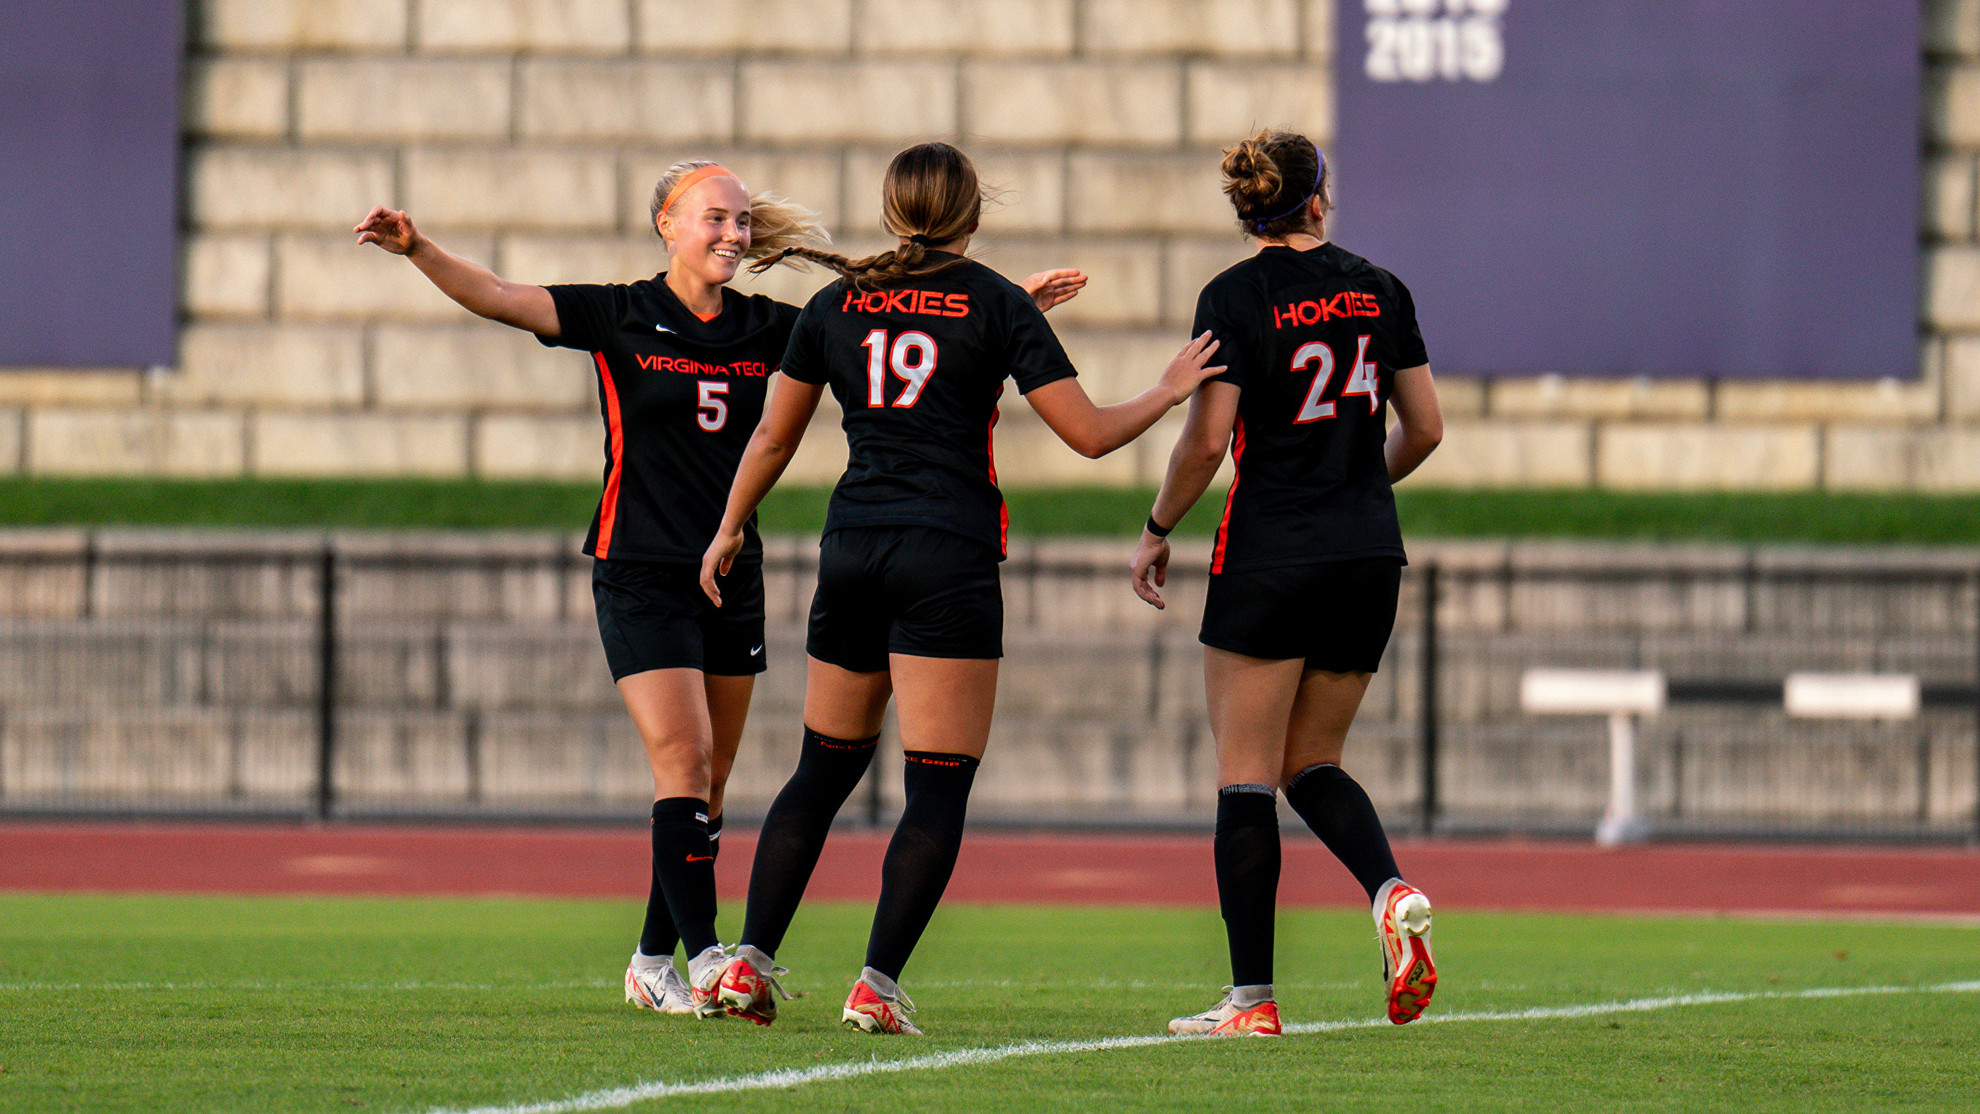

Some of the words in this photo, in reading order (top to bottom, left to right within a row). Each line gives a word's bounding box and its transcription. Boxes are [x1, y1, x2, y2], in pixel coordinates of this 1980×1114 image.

[1366, 18, 1503, 81] 2015
[842, 289, 970, 318] HOKIES
[1273, 291, 1381, 330] HOKIES
[635, 353, 730, 376] VIRGINIA
[860, 329, 938, 409] 19
[1290, 334, 1380, 425] 24
[696, 380, 729, 433] 5
[921, 758, 960, 767] GRIP
